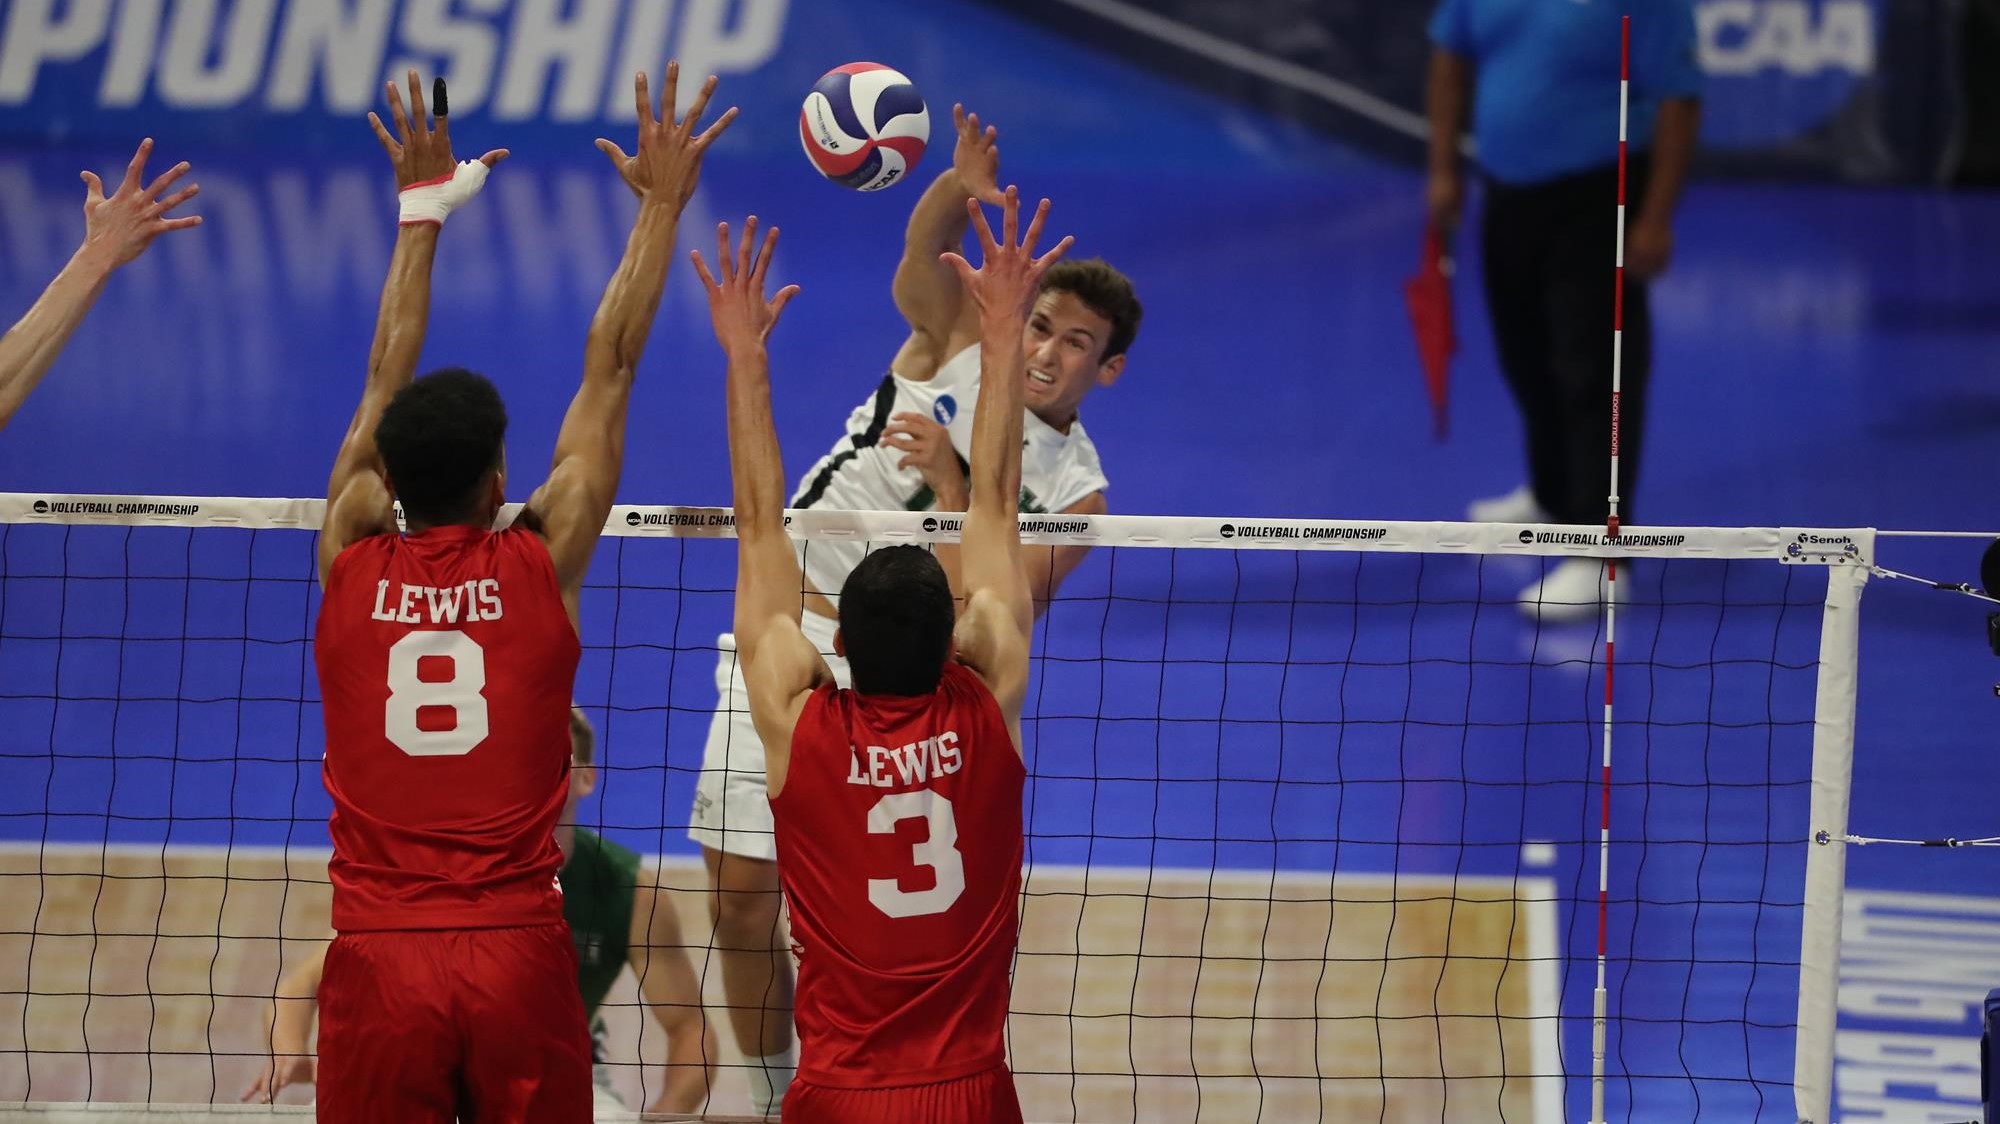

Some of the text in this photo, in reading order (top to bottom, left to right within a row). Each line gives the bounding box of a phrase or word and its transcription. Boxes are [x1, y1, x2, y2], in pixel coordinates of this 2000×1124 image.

[1694, 0, 1873, 77] CAA
[0, 0, 790, 123] PIONSHIP
[51, 502, 112, 514] VOLLEYBALL
[116, 503, 198, 515] CHAMPIONSHIP
[644, 513, 706, 526] VOLLEYBALL
[1018, 521, 1089, 533] AMPIONSHIP
[1238, 526, 1300, 538] VOLLEYBALL
[1303, 528, 1386, 539] CHAMPIONSHIP
[1536, 532, 1598, 545] VOLLEYBALL
[1602, 535, 1685, 546] CHAMPIONSHIP
[1810, 535, 1851, 544] Senoh
[371, 578, 503, 624] LEWIS
[385, 630, 489, 756] 8
[847, 731, 963, 787] LEWIS
[867, 788, 966, 919] 3
